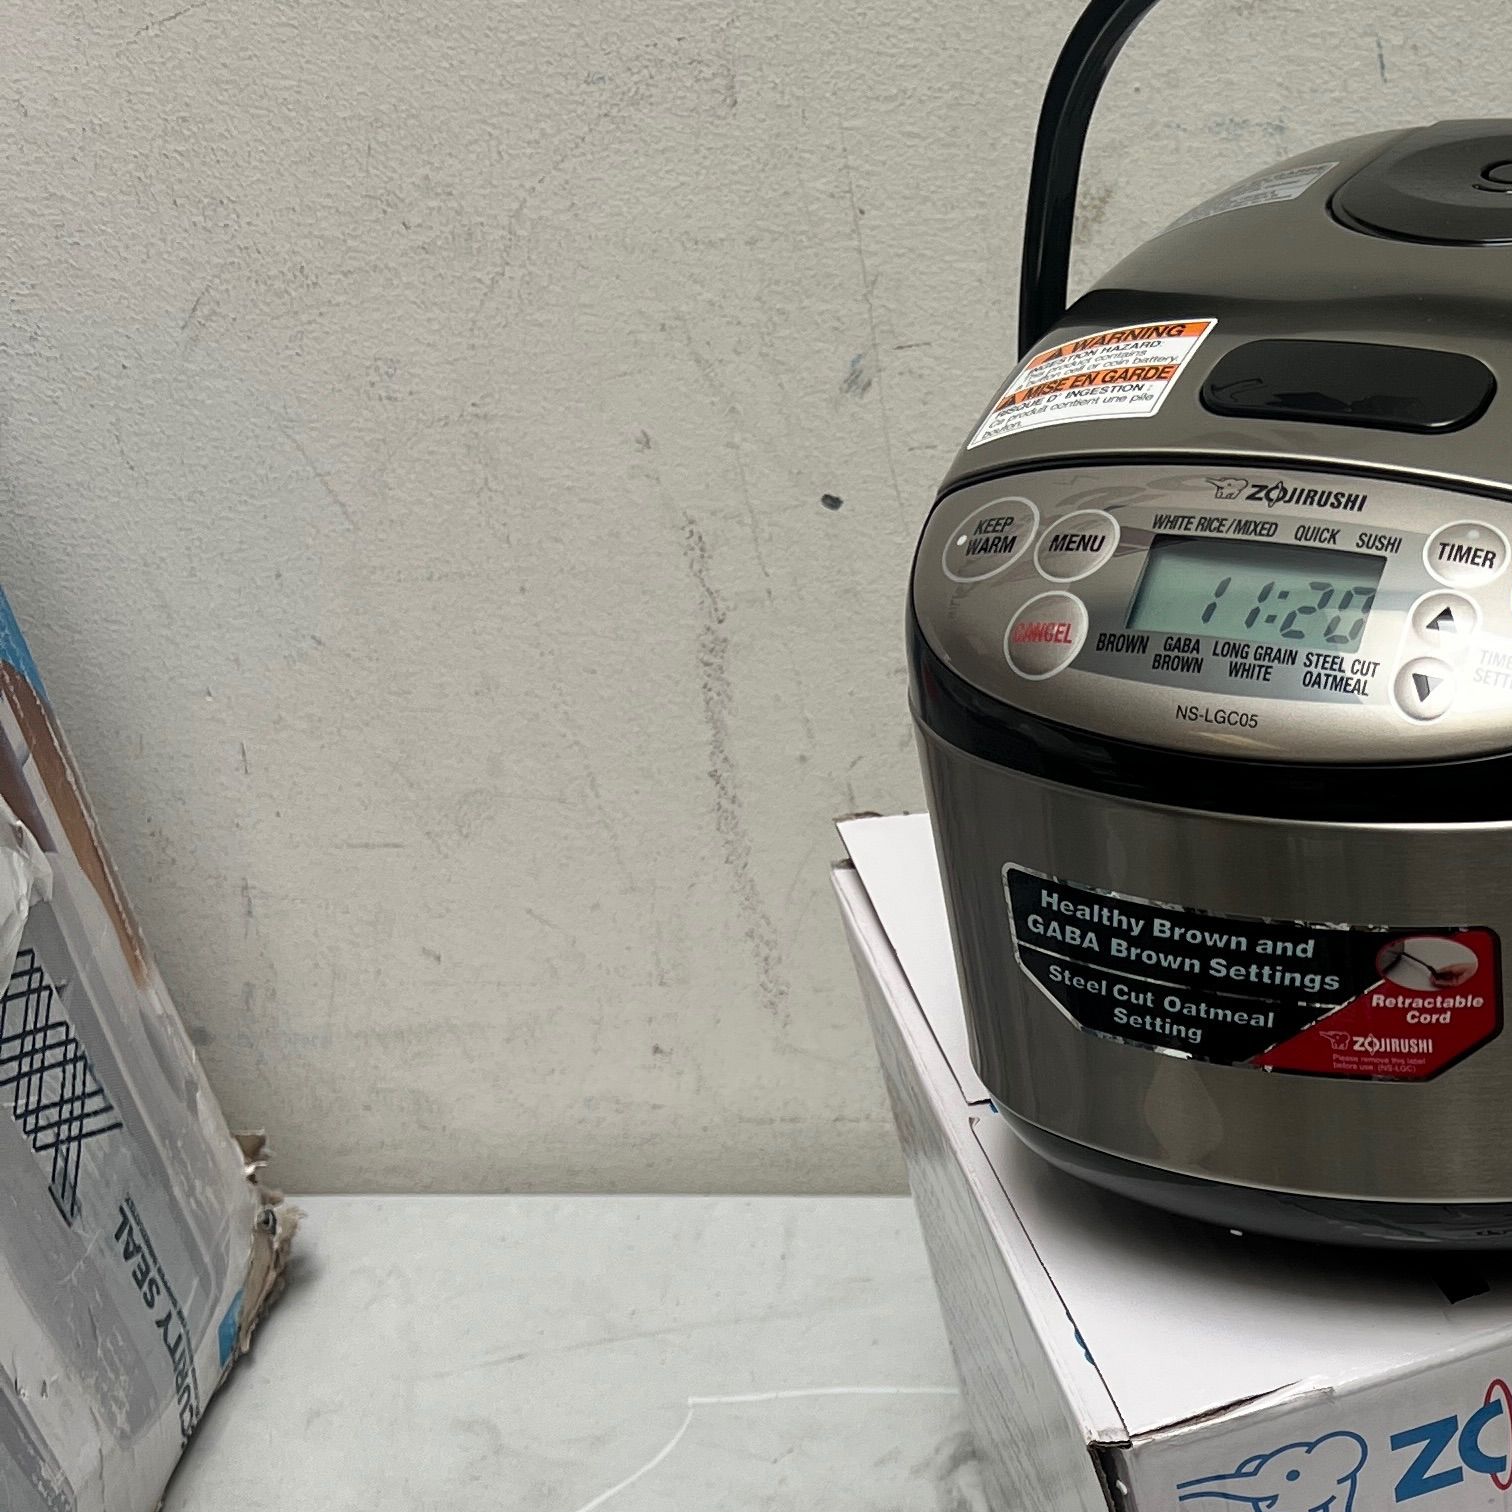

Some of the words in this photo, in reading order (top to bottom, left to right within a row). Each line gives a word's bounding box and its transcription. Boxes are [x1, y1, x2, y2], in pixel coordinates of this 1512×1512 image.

[1072, 324, 1185, 353] WARNING
[1022, 377, 1070, 402] MISE
[1069, 374, 1099, 389] EN
[1101, 365, 1174, 386] GARDE
[1065, 384, 1145, 399] INGESTION
[1050, 396, 1101, 411] contient
[1245, 481, 1368, 513] ZOJIRUSHI
[974, 516, 1014, 535] KEEP
[1152, 514, 1196, 532] WHITE
[966, 536, 1017, 556] WARM
[1049, 535, 1106, 552] MENU
[1294, 525, 1341, 545] QUICK
[1355, 532, 1403, 554] SUSHI
[1437, 543, 1497, 569] TIMER
[1201, 577, 1377, 645] 11:20
[1096, 633, 1149, 655] BROWN
[1163, 636, 1200, 654] GABA
[1212, 640, 1251, 660] LONG
[1253, 645, 1298, 666] GRAIN
[1152, 653, 1204, 674] BROWN
[1228, 661, 1273, 682] WHITE
[1303, 652, 1346, 674] STEEL
[1351, 659, 1381, 679] CUT
[1302, 671, 1369, 696] OATMEAL
[1175, 704, 1260, 730] NS-LGC05
[1041, 888, 1145, 937] Healthy
[1152, 919, 1248, 952] Brown
[1255, 938, 1315, 959] and
[1027, 914, 1100, 952] GABA
[1111, 937, 1201, 974] Brown
[1208, 957, 1340, 993] Settings
[1049, 964, 1107, 996] Steel
[1112, 983, 1155, 1008] Cut
[1163, 995, 1274, 1029] Oatmeal
[1371, 994, 1485, 1010] Retractable
[1113, 1007, 1203, 1044] Setting
[1406, 1010, 1451, 1025] Cord
[1352, 1033, 1434, 1056] ZOJIRUSHI
[114, 1203, 161, 1310] SEAL
